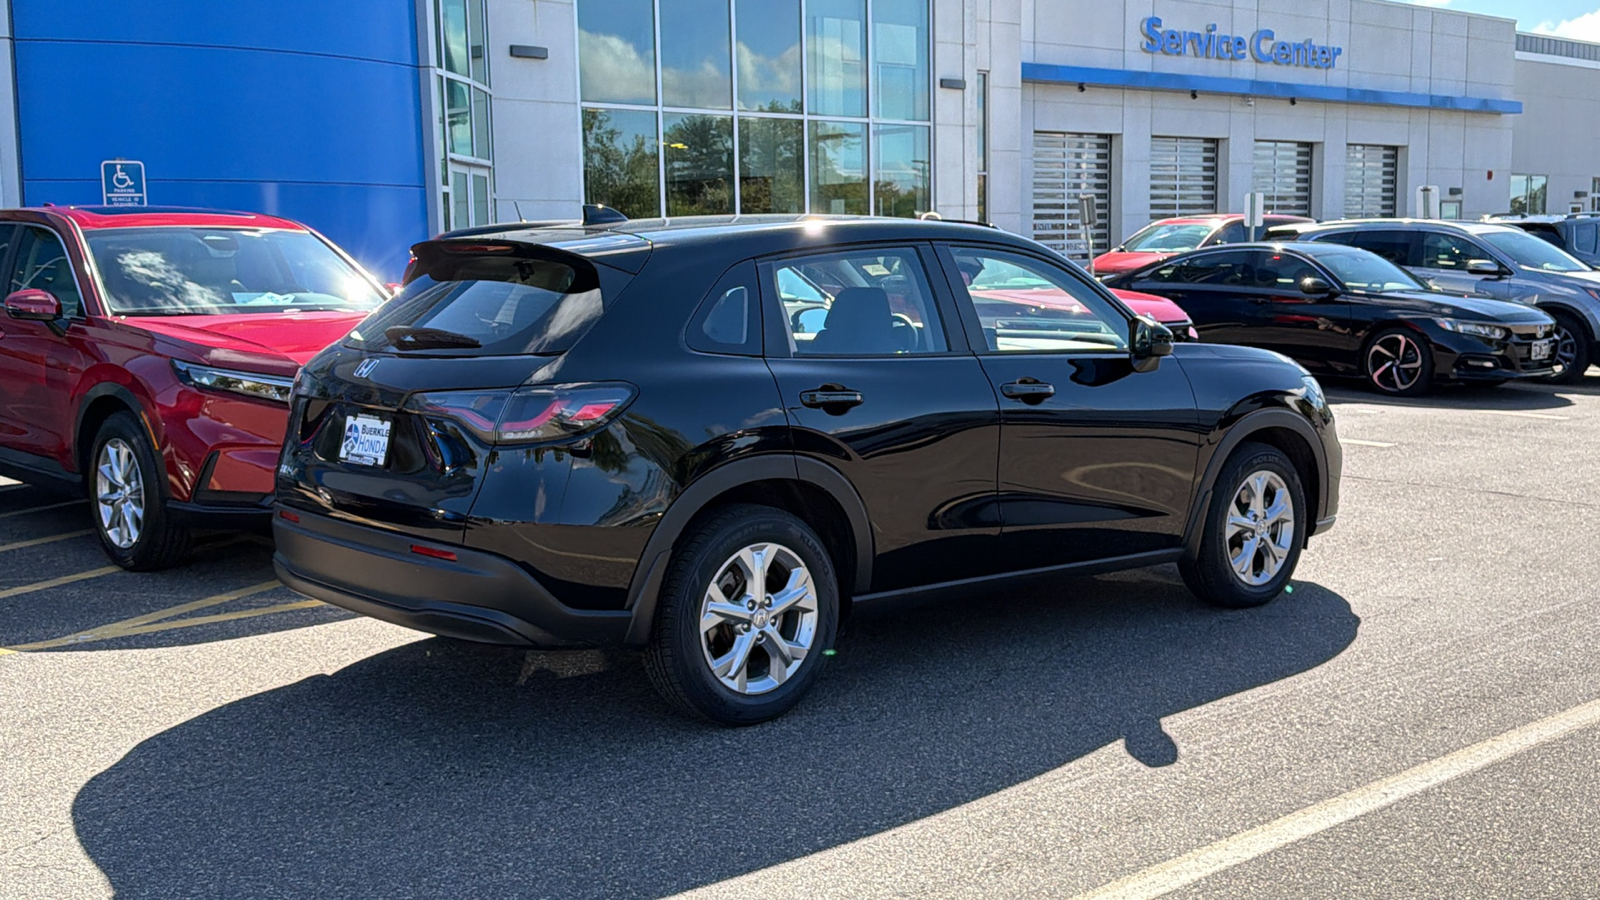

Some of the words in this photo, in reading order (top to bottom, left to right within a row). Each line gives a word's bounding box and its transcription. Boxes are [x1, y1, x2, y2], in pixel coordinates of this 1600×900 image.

[1140, 16, 1246, 60] Service
[1251, 28, 1342, 68] Center
[361, 424, 390, 437] BUERKLE
[358, 435, 386, 454] HONDA
